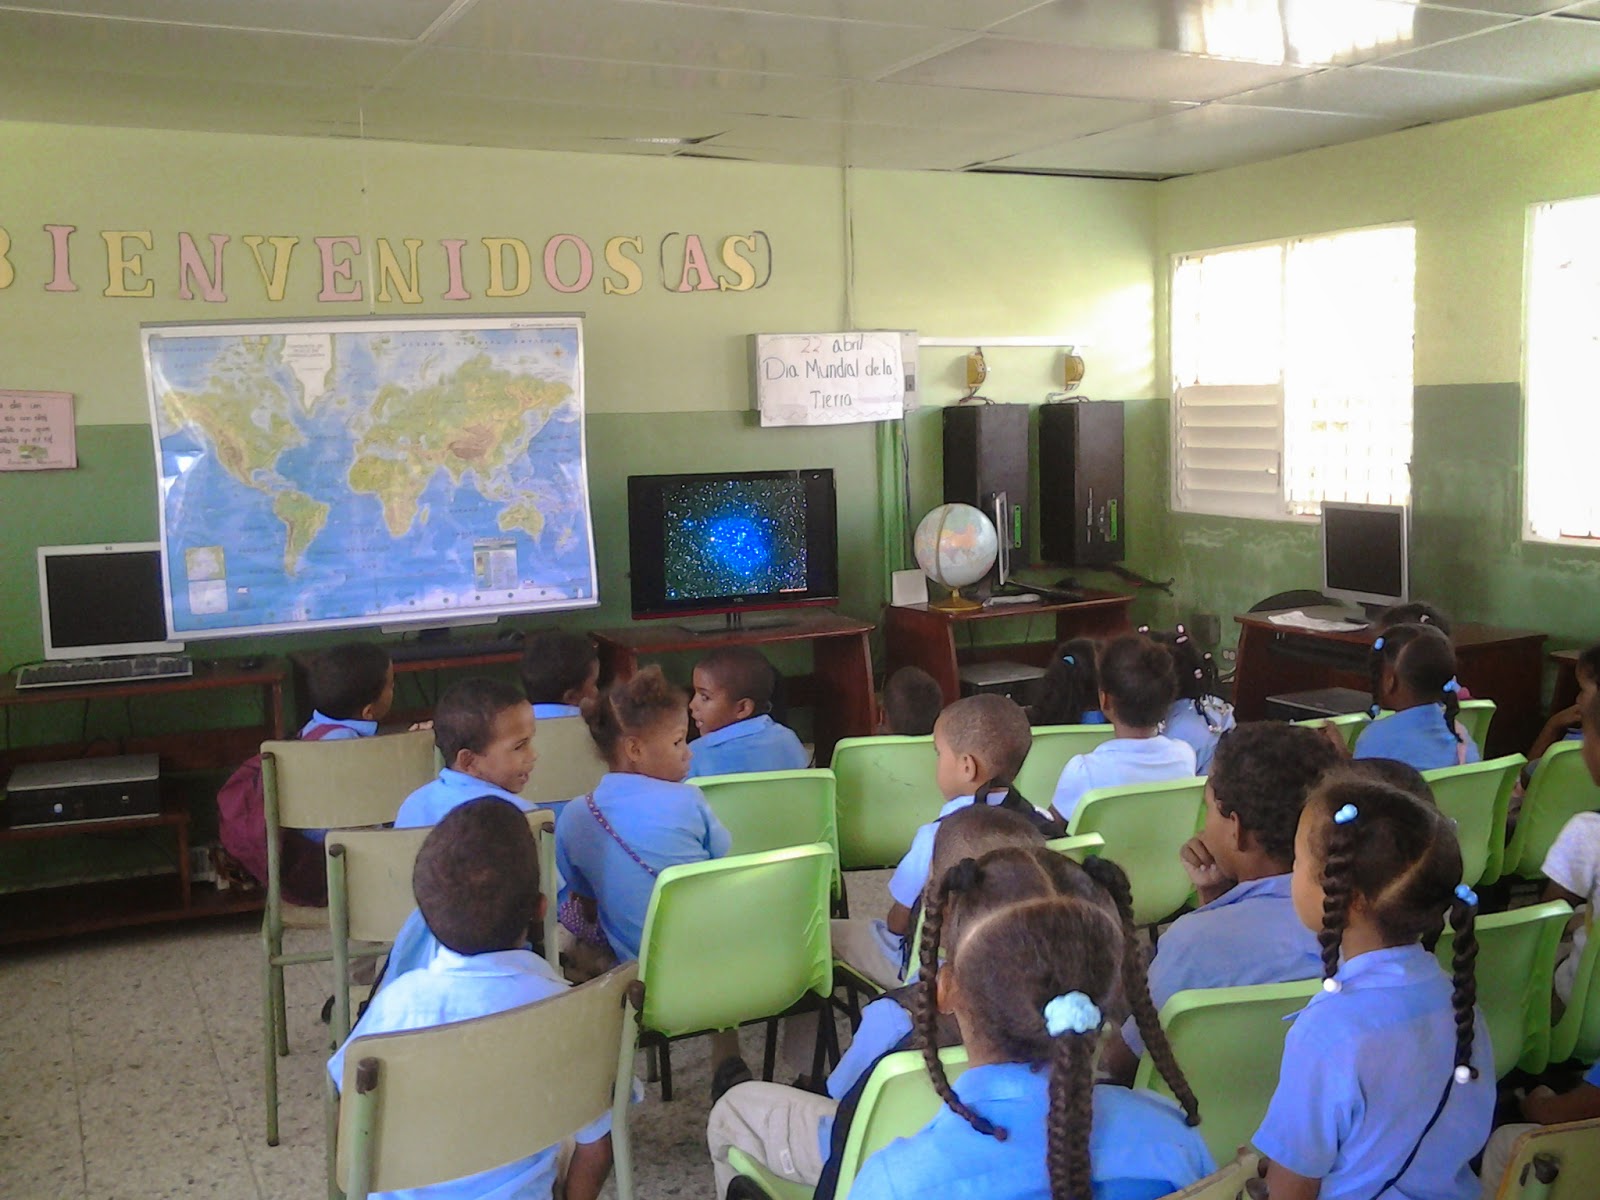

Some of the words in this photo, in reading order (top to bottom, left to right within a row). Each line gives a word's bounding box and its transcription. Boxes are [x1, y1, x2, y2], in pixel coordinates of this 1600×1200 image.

[801, 337, 823, 353] 22
[832, 334, 863, 353] abril
[763, 356, 799, 380] Dia
[806, 357, 859, 379] Mundial
[810, 390, 852, 409] Tierra
